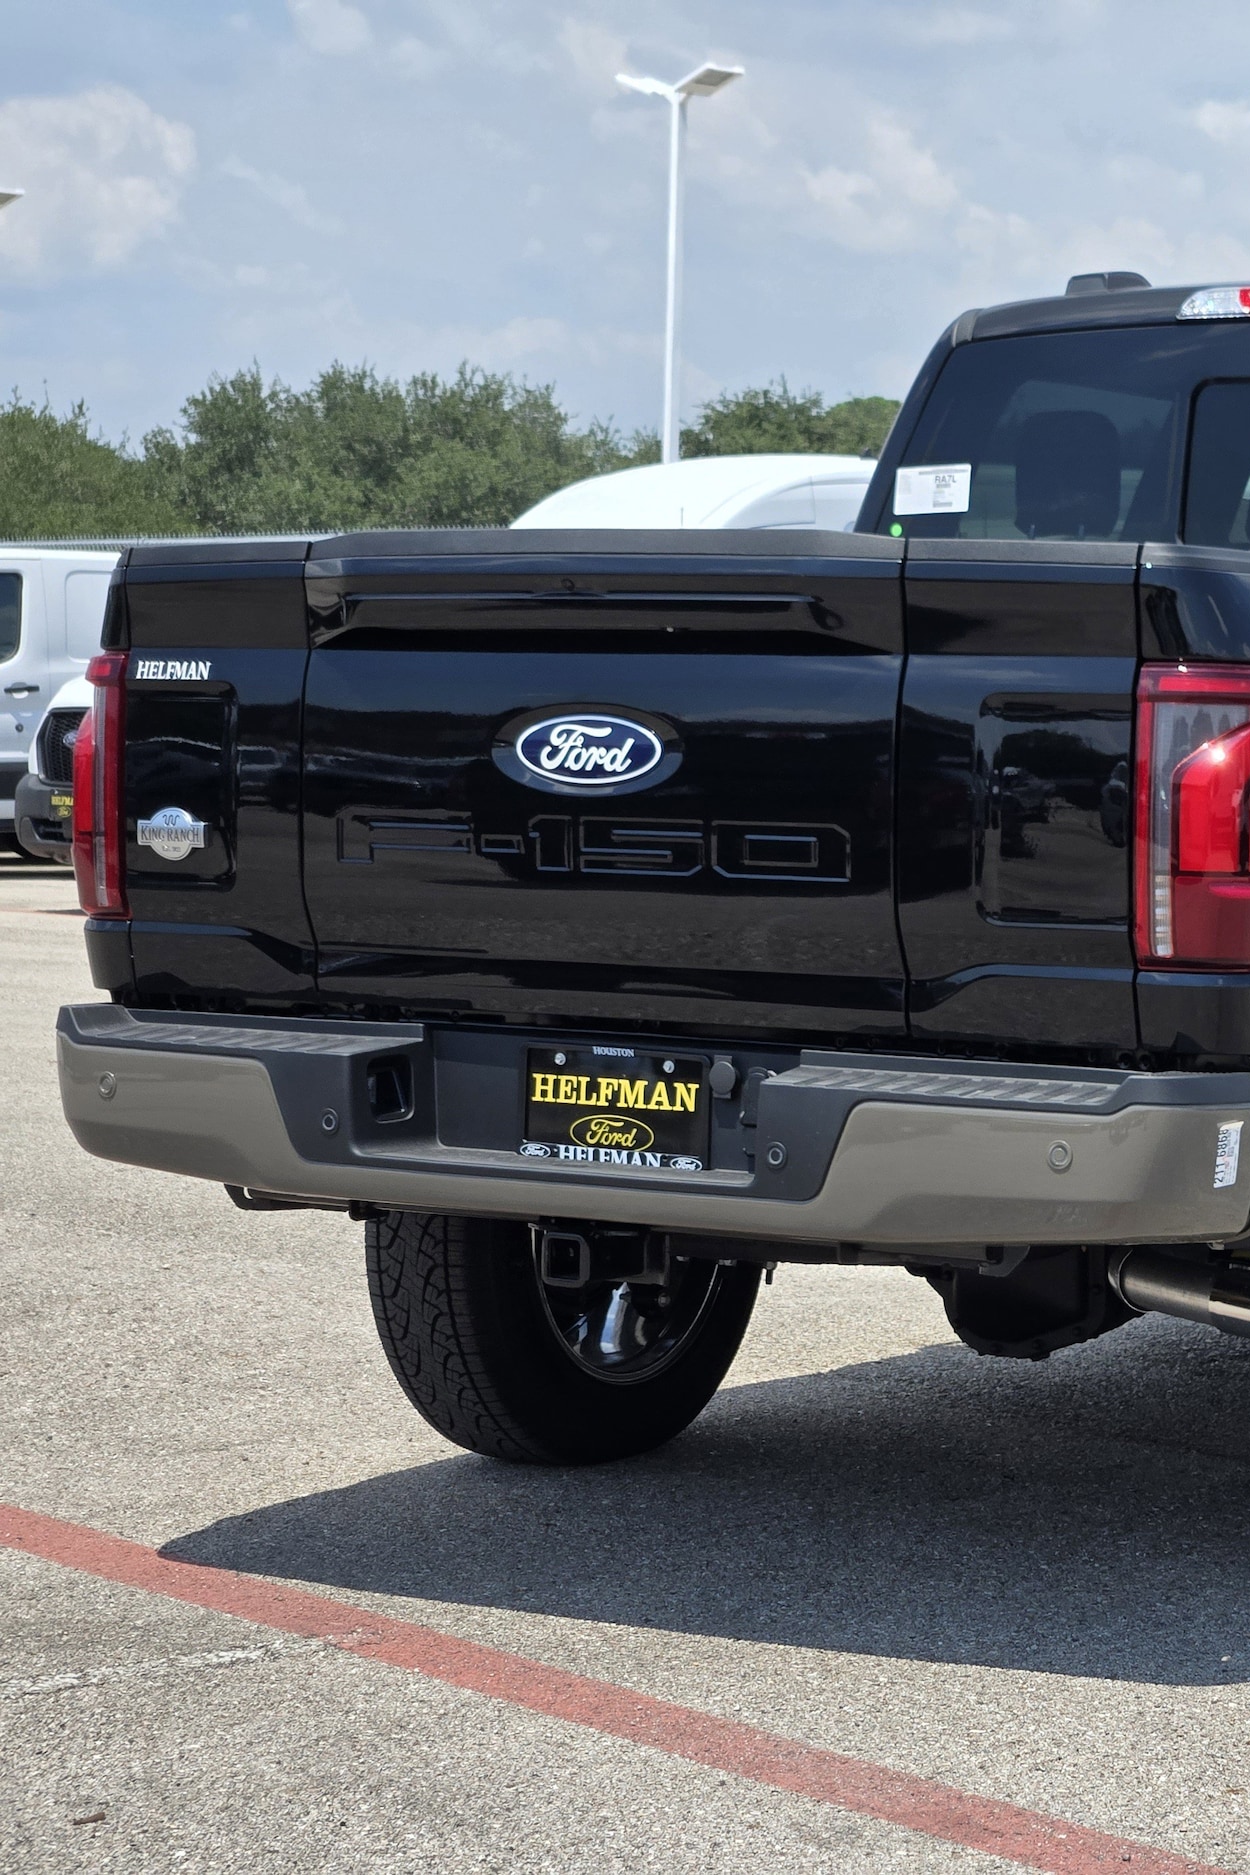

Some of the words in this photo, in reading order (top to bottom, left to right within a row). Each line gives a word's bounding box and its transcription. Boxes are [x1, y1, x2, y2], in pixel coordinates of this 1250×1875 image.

[136, 659, 212, 681] HELFMAN
[539, 723, 633, 773] Ford
[141, 826, 165, 842] KING
[167, 827, 200, 843] RANCH
[336, 804, 852, 883] F-150
[592, 1045, 635, 1058] HOUSTON
[531, 1072, 700, 1112] HELFMAN
[585, 1118, 638, 1148] Ford
[525, 1145, 546, 1157] Ford
[674, 1158, 696, 1171] Ford
